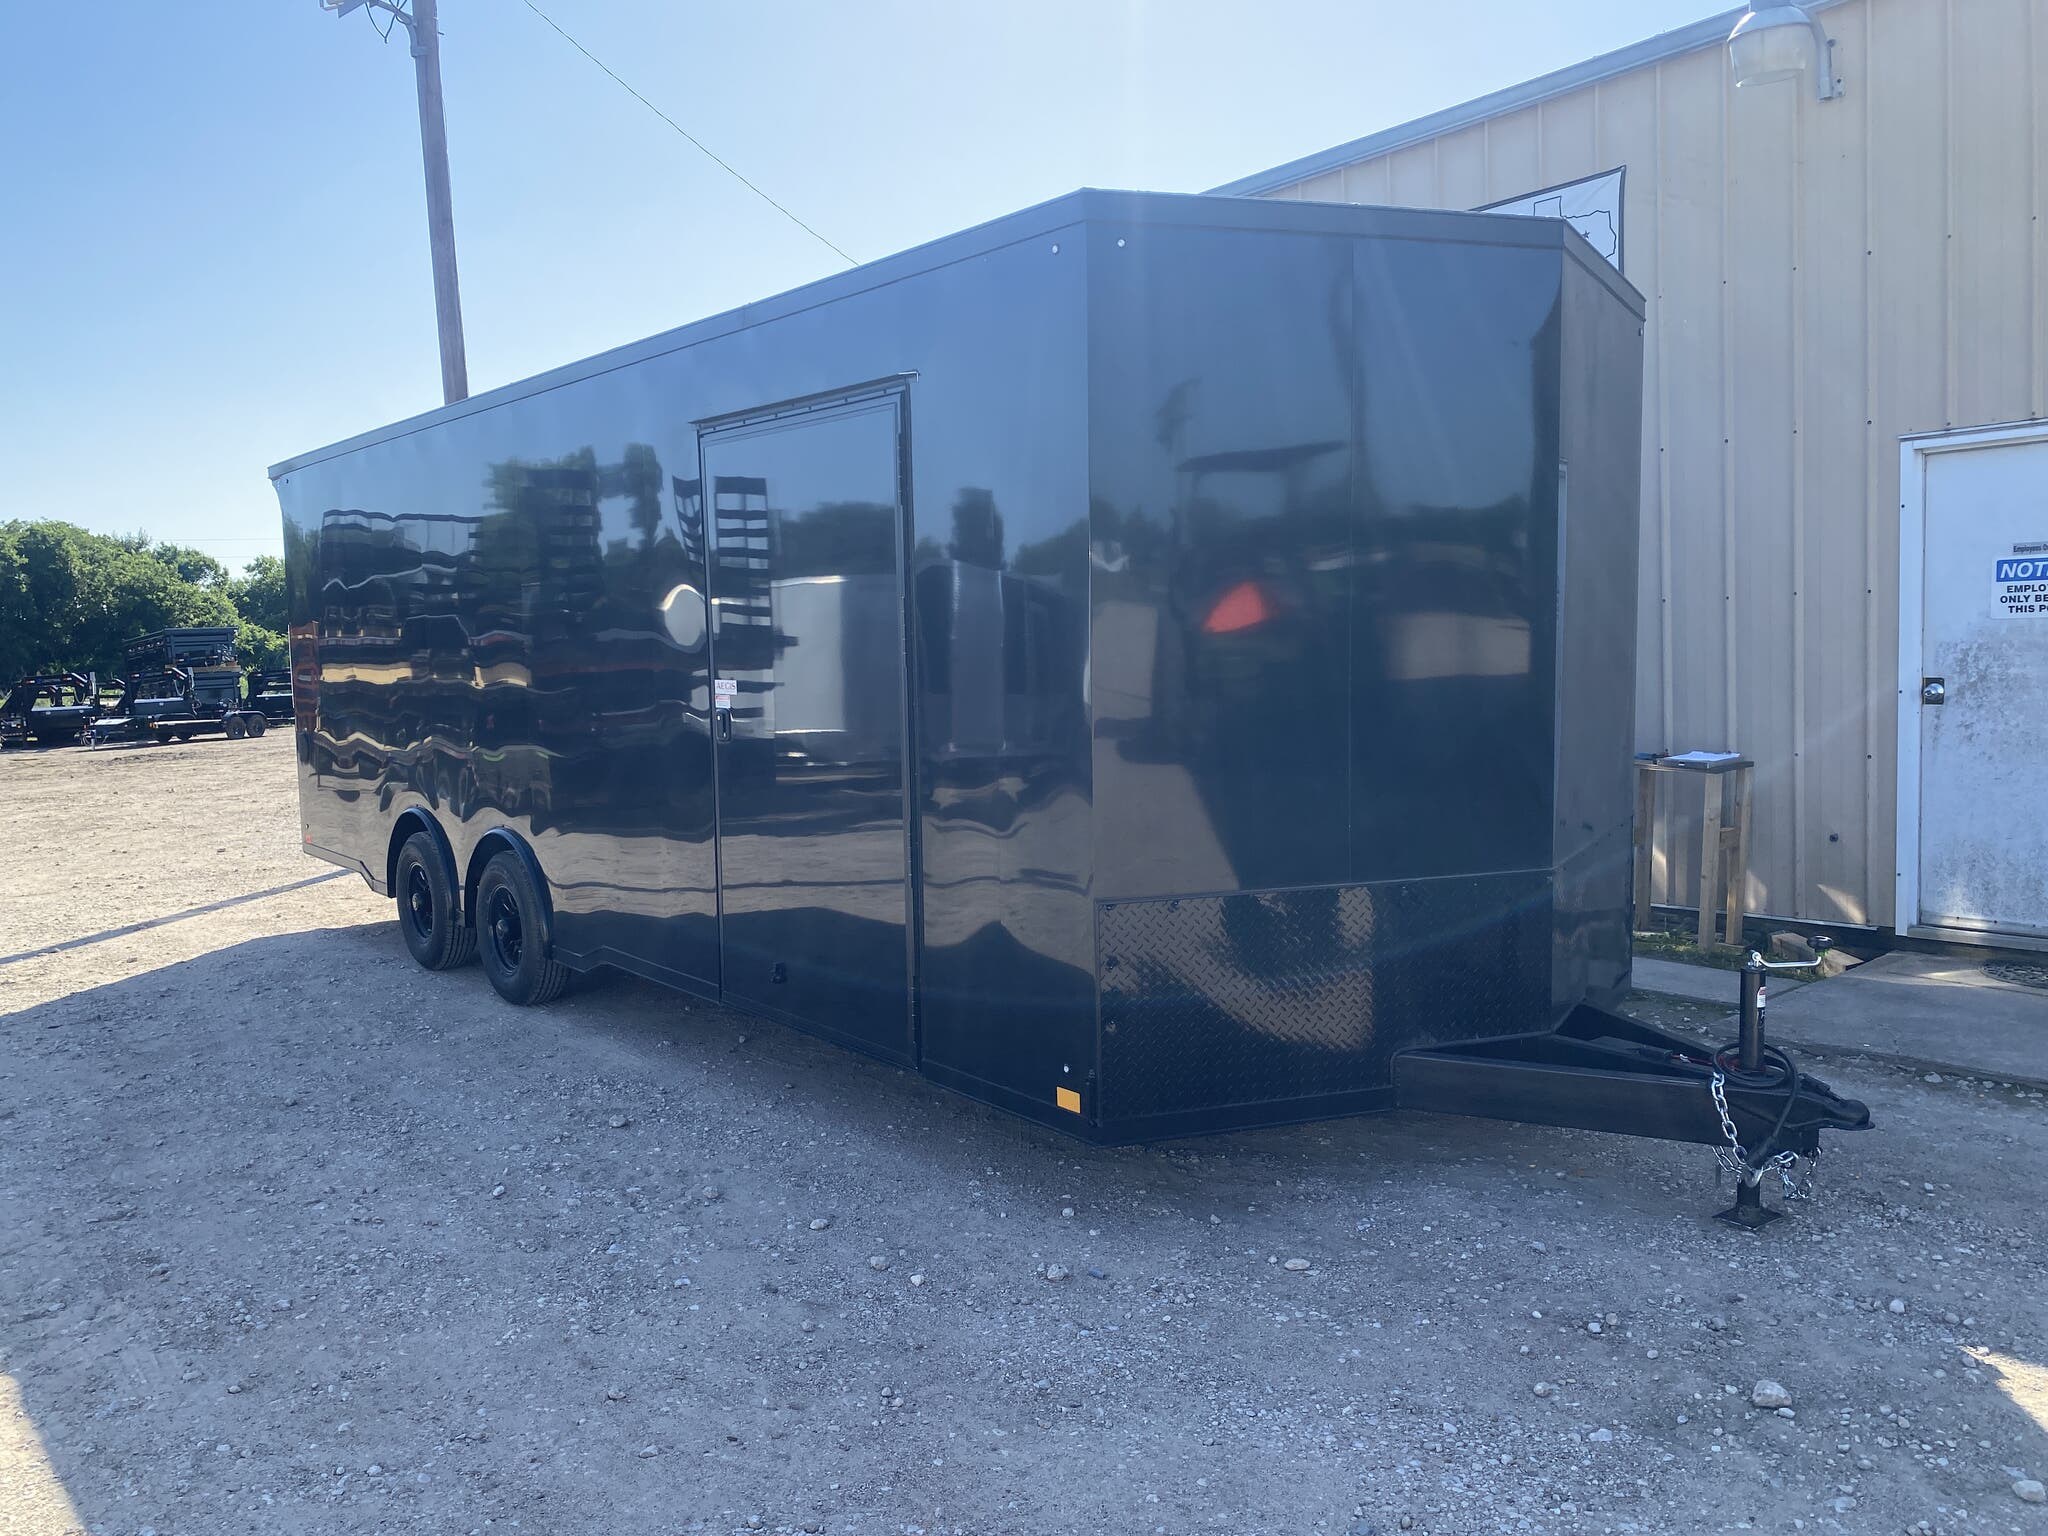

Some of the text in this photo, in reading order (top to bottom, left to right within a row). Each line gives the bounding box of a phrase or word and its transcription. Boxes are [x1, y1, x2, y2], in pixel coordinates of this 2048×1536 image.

[2007, 584, 2048, 593] EMPLO
[2000, 595, 2030, 604] ONLY
[2008, 604, 2048, 613] THIS P
